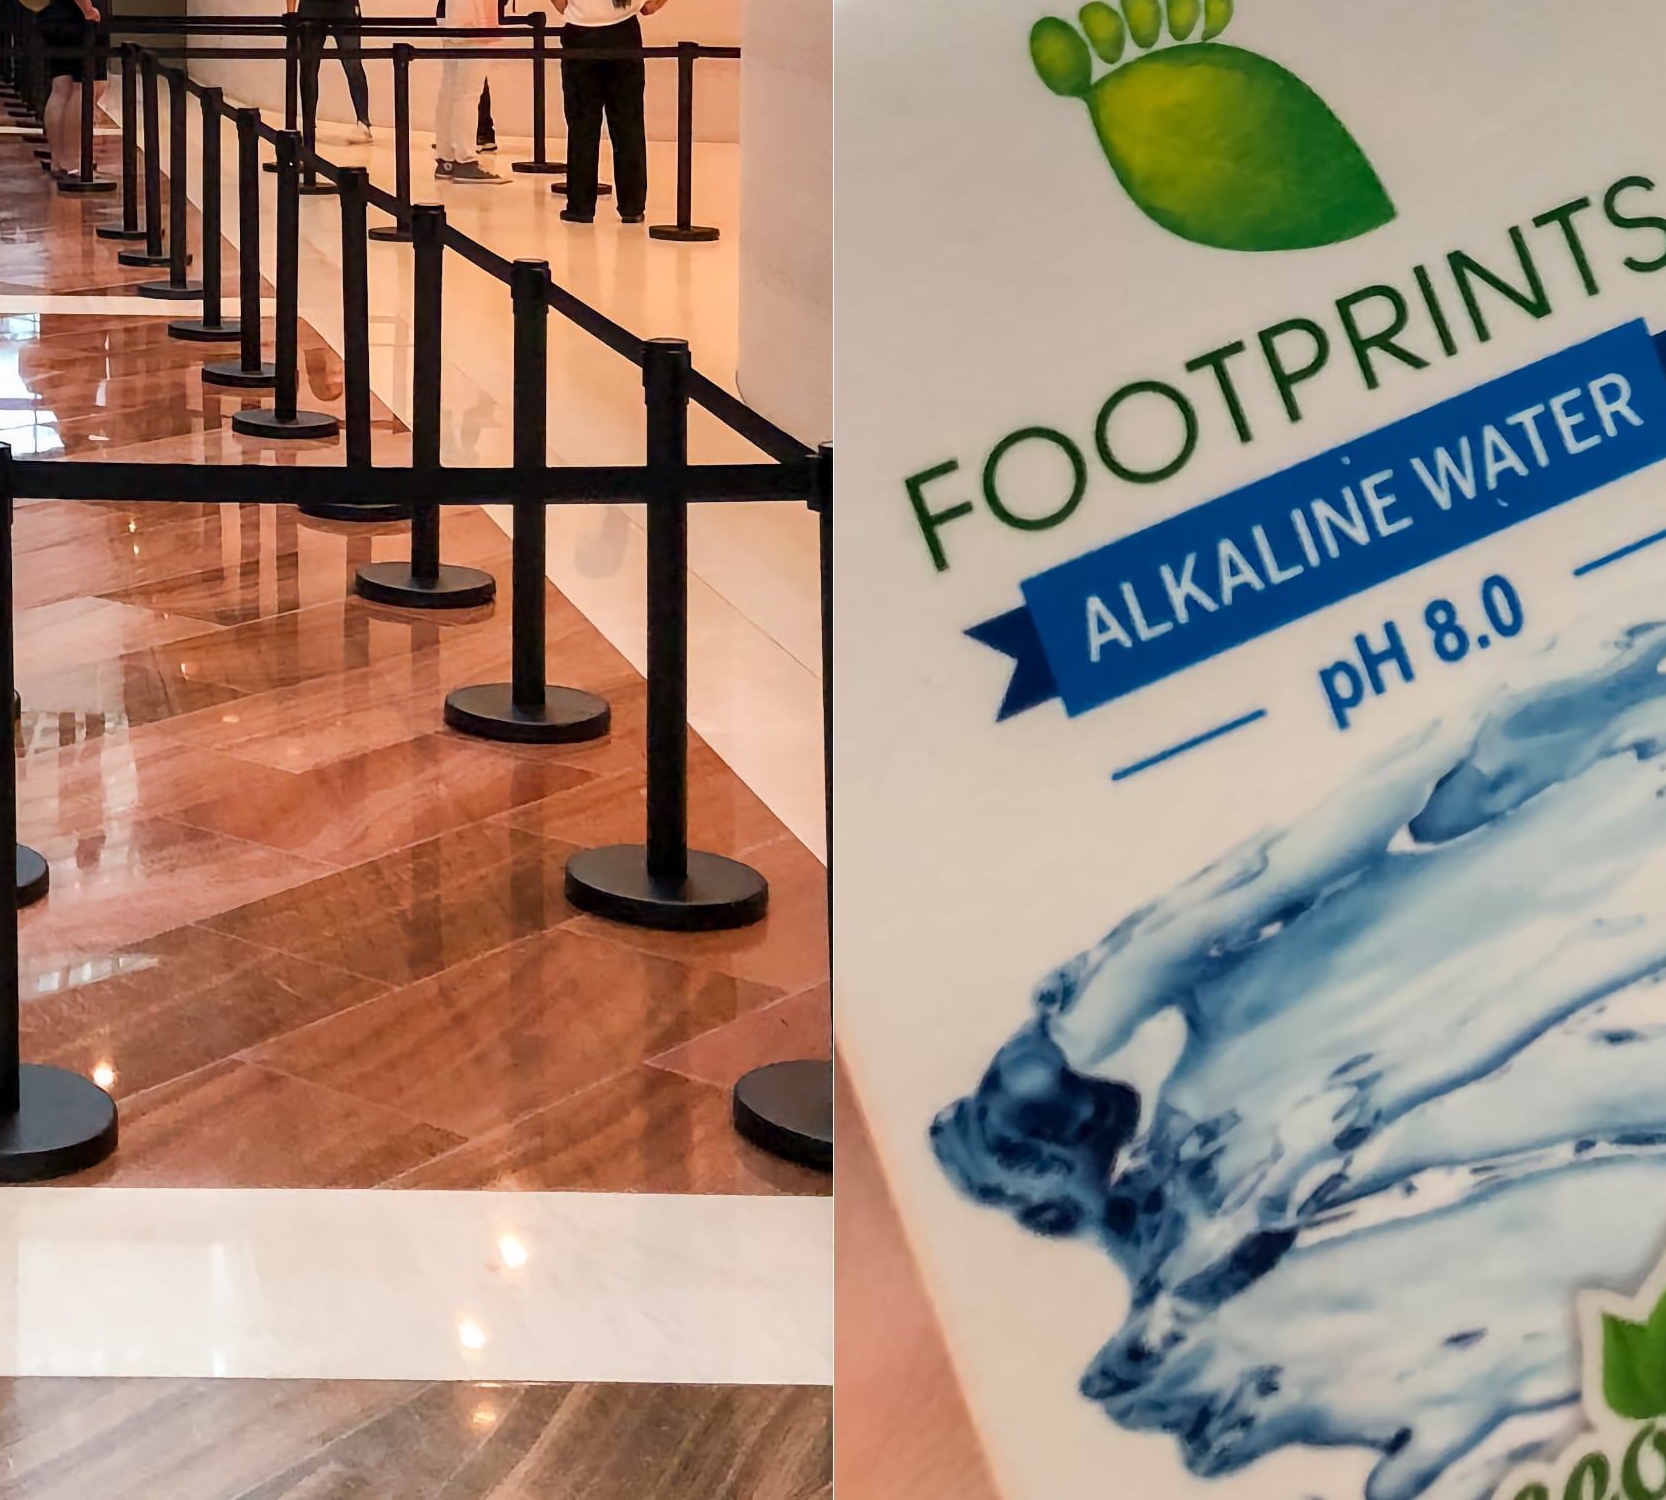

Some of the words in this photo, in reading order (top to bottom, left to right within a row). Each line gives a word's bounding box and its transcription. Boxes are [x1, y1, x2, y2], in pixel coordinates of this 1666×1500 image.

[1084, 469, 1414, 663] ALKALINE
[1410, 372, 1645, 512] WATER
[1317, 619, 1414, 730] pH
[1429, 572, 1526, 664] 8.0
